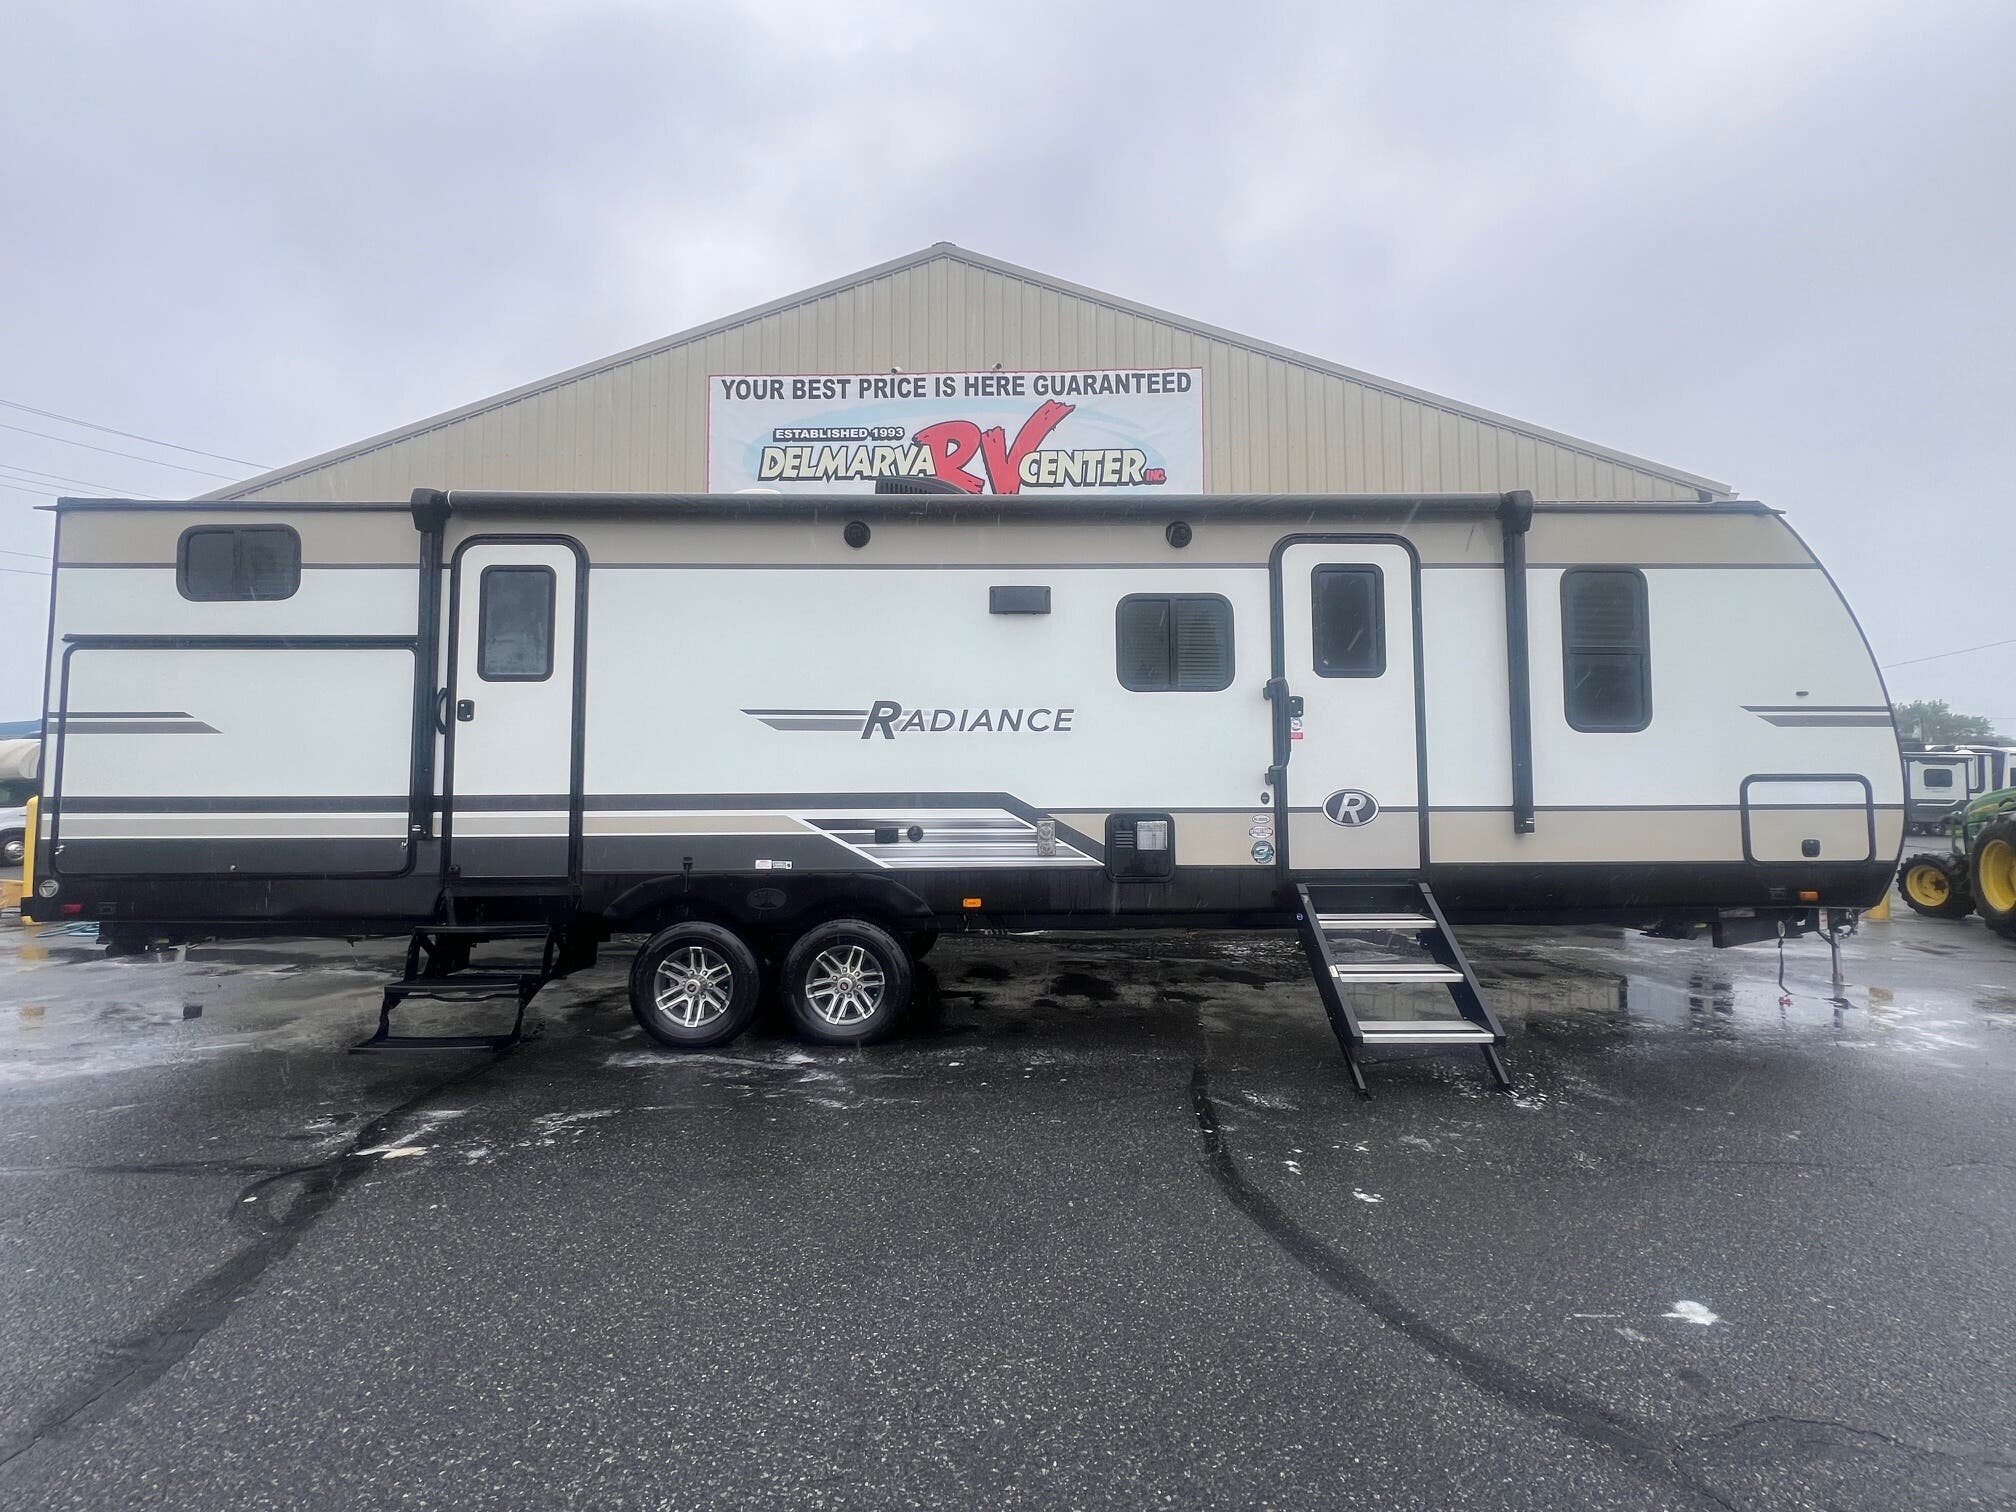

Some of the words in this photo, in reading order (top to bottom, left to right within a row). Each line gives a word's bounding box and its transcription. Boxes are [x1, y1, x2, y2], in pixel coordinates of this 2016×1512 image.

[721, 378, 784, 400] YOUR
[792, 378, 851, 399] BEST
[859, 377, 928, 398] PRICE
[935, 376, 955, 397] IS
[965, 375, 1025, 396] HERE
[1034, 372, 1192, 395] GUARANTEED
[758, 444, 936, 481] DELMARVA
[913, 399, 1076, 495] RV
[1018, 449, 1148, 486] CENTER
[775, 428, 868, 440] ESTABLISHED
[872, 427, 904, 439] 1993
[1336, 793, 1367, 824] R
